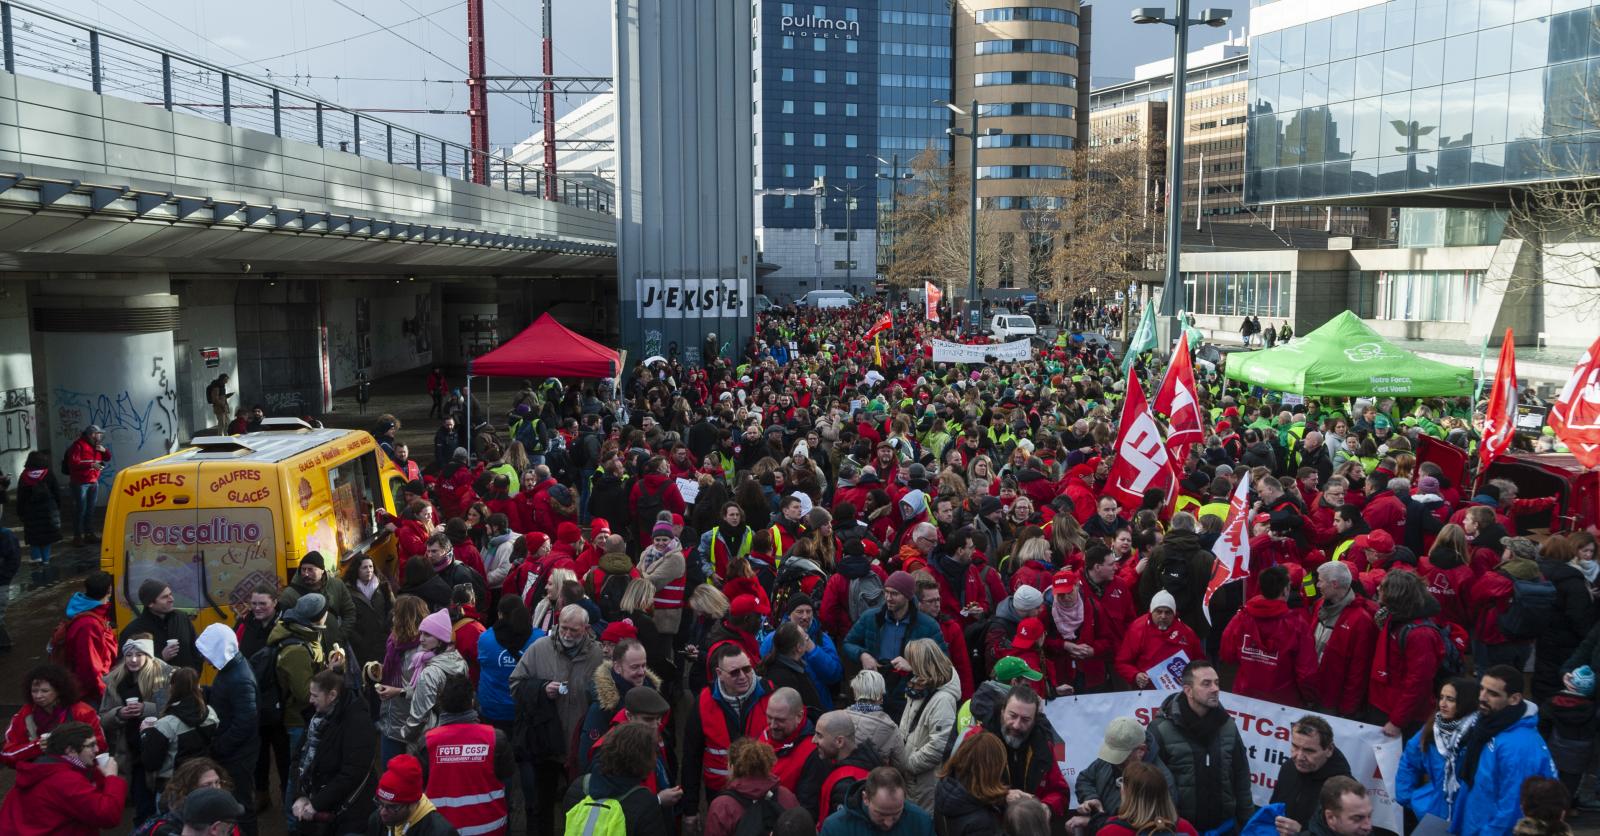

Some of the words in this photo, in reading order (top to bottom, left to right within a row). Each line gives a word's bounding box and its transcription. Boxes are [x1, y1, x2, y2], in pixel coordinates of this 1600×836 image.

[781, 14, 860, 36] pullman
[788, 31, 852, 40] HOTELS
[124, 473, 186, 497] WAFELS
[210, 469, 261, 493] GAUFRES
[140, 491, 167, 508] IJS
[227, 487, 271, 503] GLACES
[134, 516, 262, 546] Pascalino
[439, 746, 461, 756] FGTB
[465, 746, 487, 755] CGSP
